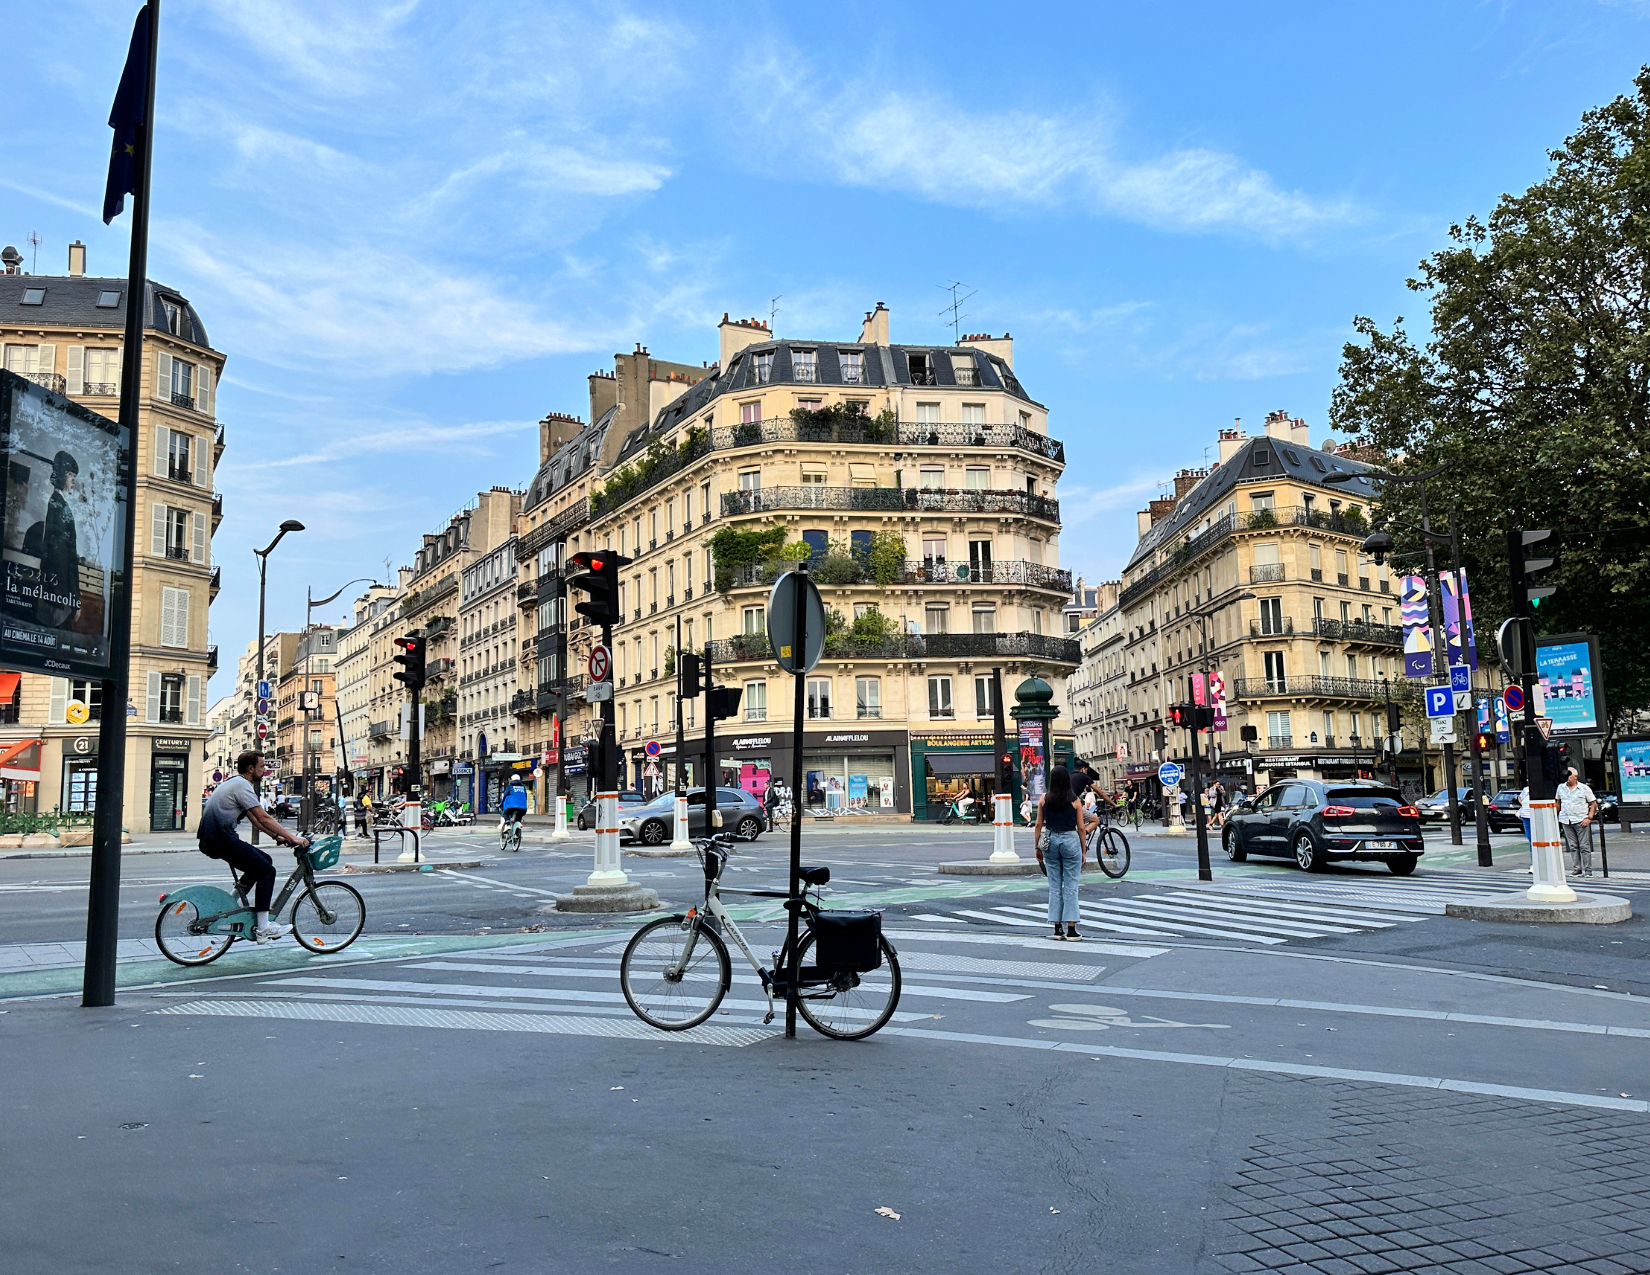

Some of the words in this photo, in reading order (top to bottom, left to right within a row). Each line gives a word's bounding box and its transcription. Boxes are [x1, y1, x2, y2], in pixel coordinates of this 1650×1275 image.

[6, 576, 18, 593] la
[22, 584, 82, 609] mélancolie
[4, 628, 12, 638] AU
[12, 629, 31, 642] CINÉMA
[30, 634, 37, 643] LE
[38, 635, 43, 644] 14
[44, 660, 71, 670] JCDecaux
[1548, 654, 1578, 664] TERRASSE
[1433, 692, 1446, 712] P
[927, 739, 970, 747] BOULANGERIE
[726, 922, 749, 951] BATAVUS
